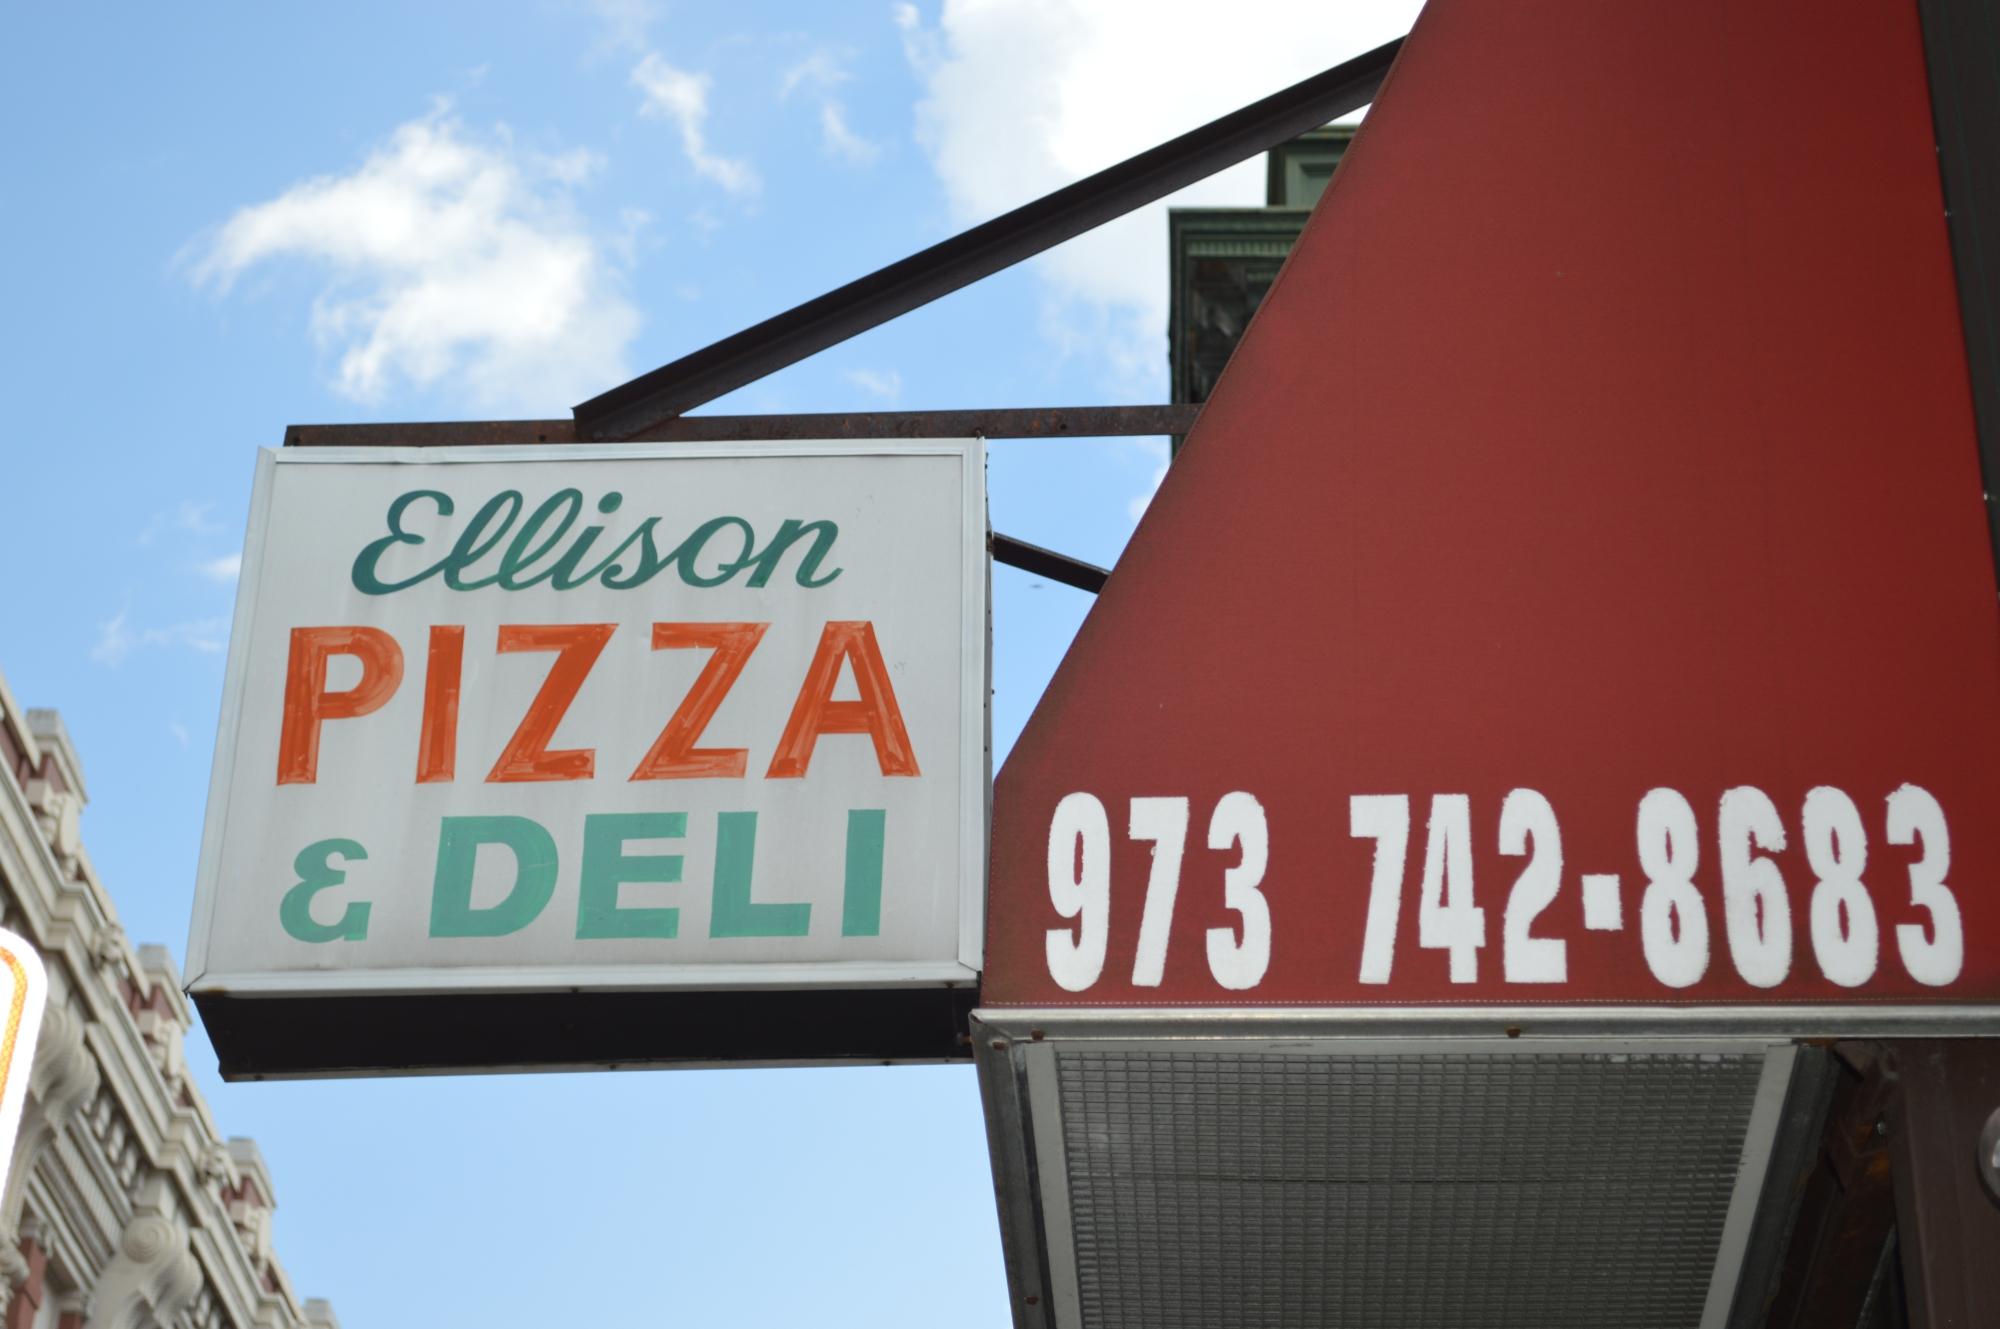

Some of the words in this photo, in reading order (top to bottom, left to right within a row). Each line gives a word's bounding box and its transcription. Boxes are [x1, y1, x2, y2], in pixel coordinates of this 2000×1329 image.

[352, 487, 842, 595] Ellison
[277, 620, 921, 785] PIZZA
[281, 839, 371, 943] &
[429, 809, 886, 938] DELI
[1045, 790, 1272, 992] 973
[1349, 782, 1964, 988] 742-8683
